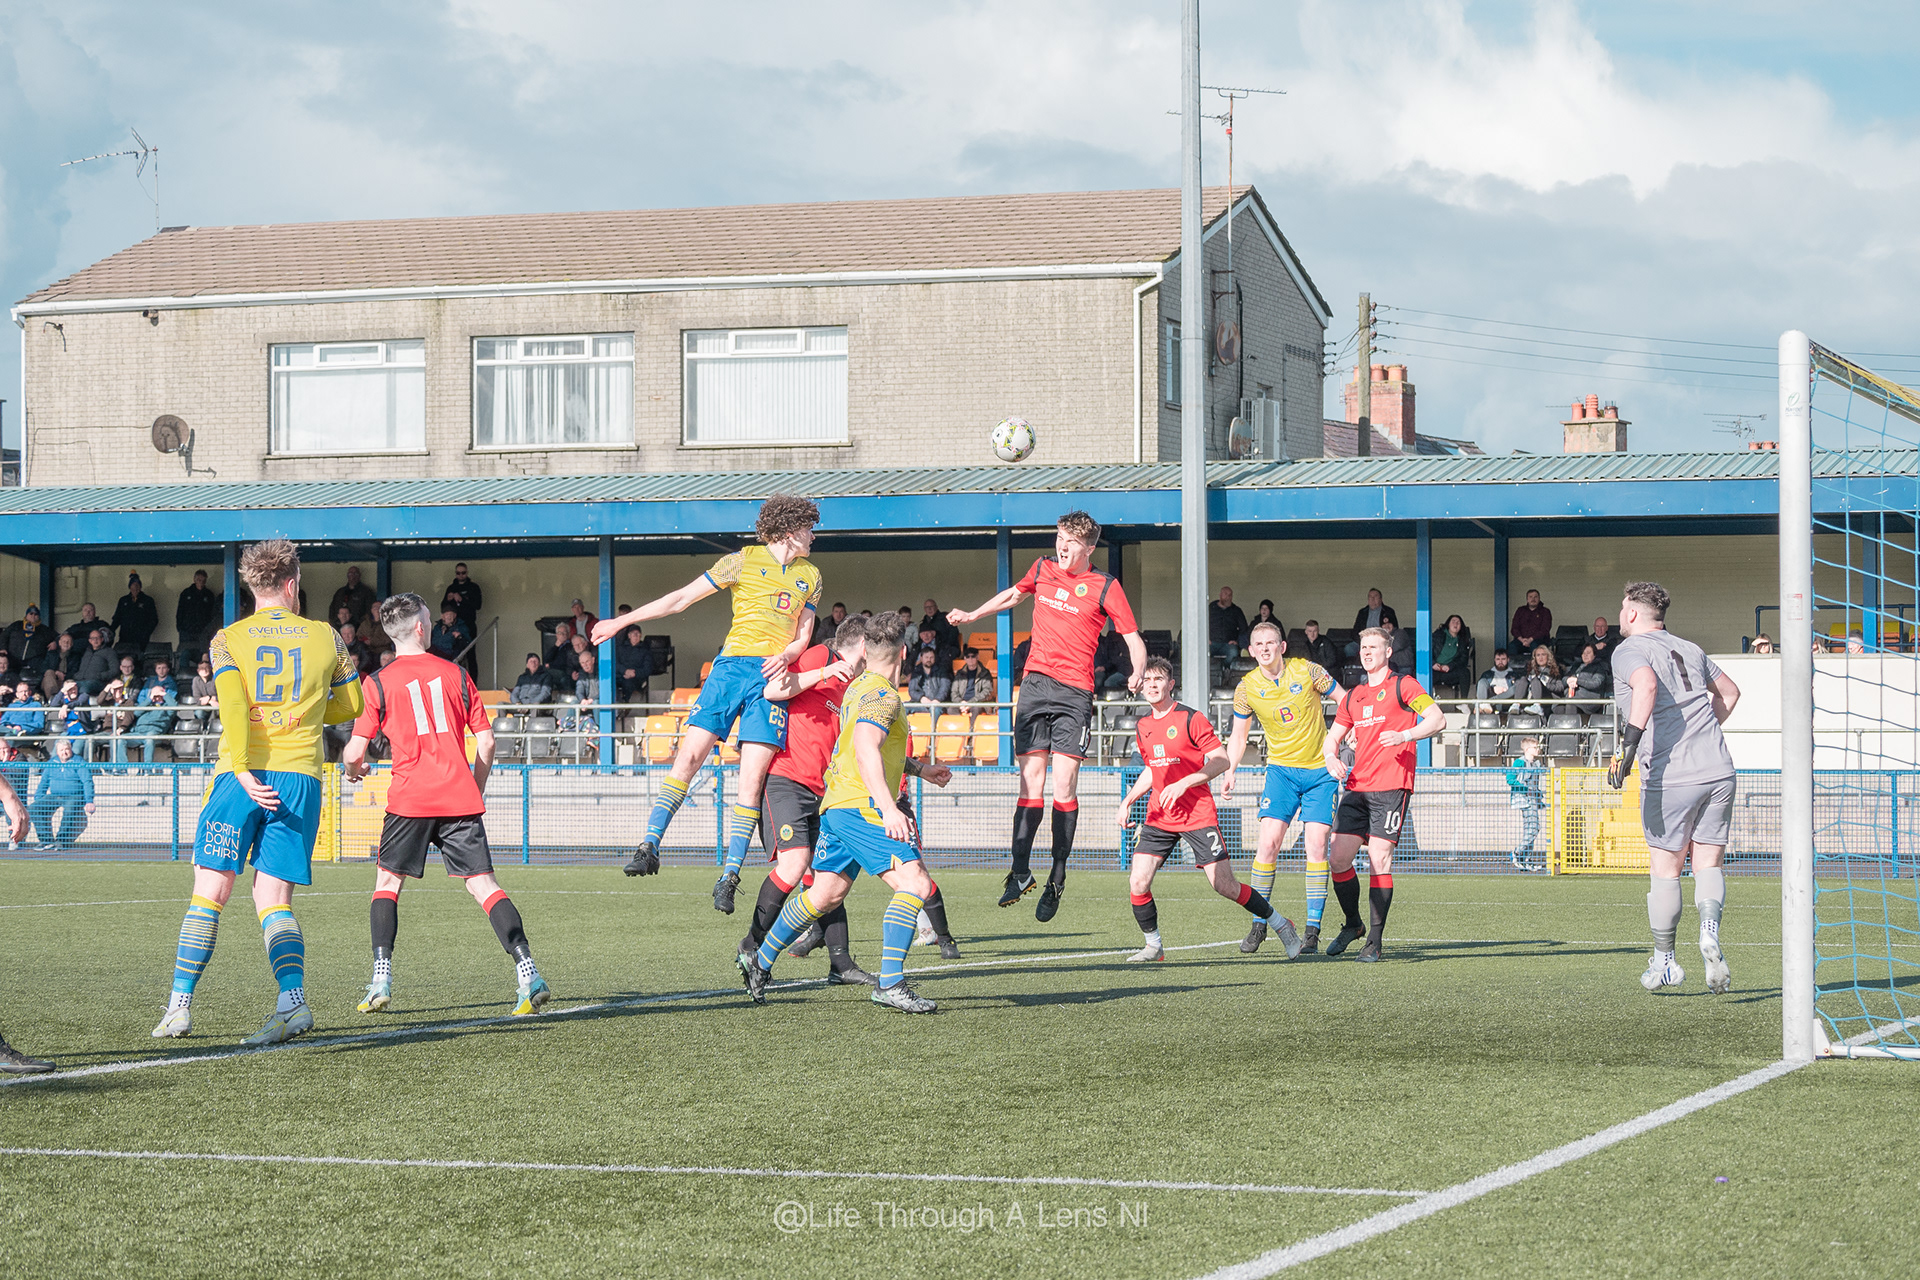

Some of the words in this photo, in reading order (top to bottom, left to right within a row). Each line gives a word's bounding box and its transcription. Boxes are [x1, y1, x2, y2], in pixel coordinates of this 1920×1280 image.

[776, 592, 791, 610] B
[255, 645, 303, 702] 21
[1670, 649, 1693, 692] 1
[249, 706, 264, 722] G
[270, 711, 283, 725] &
[288, 712, 305, 727] H
[405, 676, 449, 736] 11
[769, 704, 786, 728] 25
[1279, 707, 1294, 723] B
[206, 820, 241, 839] NORTH
[1384, 810, 1401, 831] 10
[205, 831, 240, 850] DOWN
[1206, 831, 1222, 852] 2
